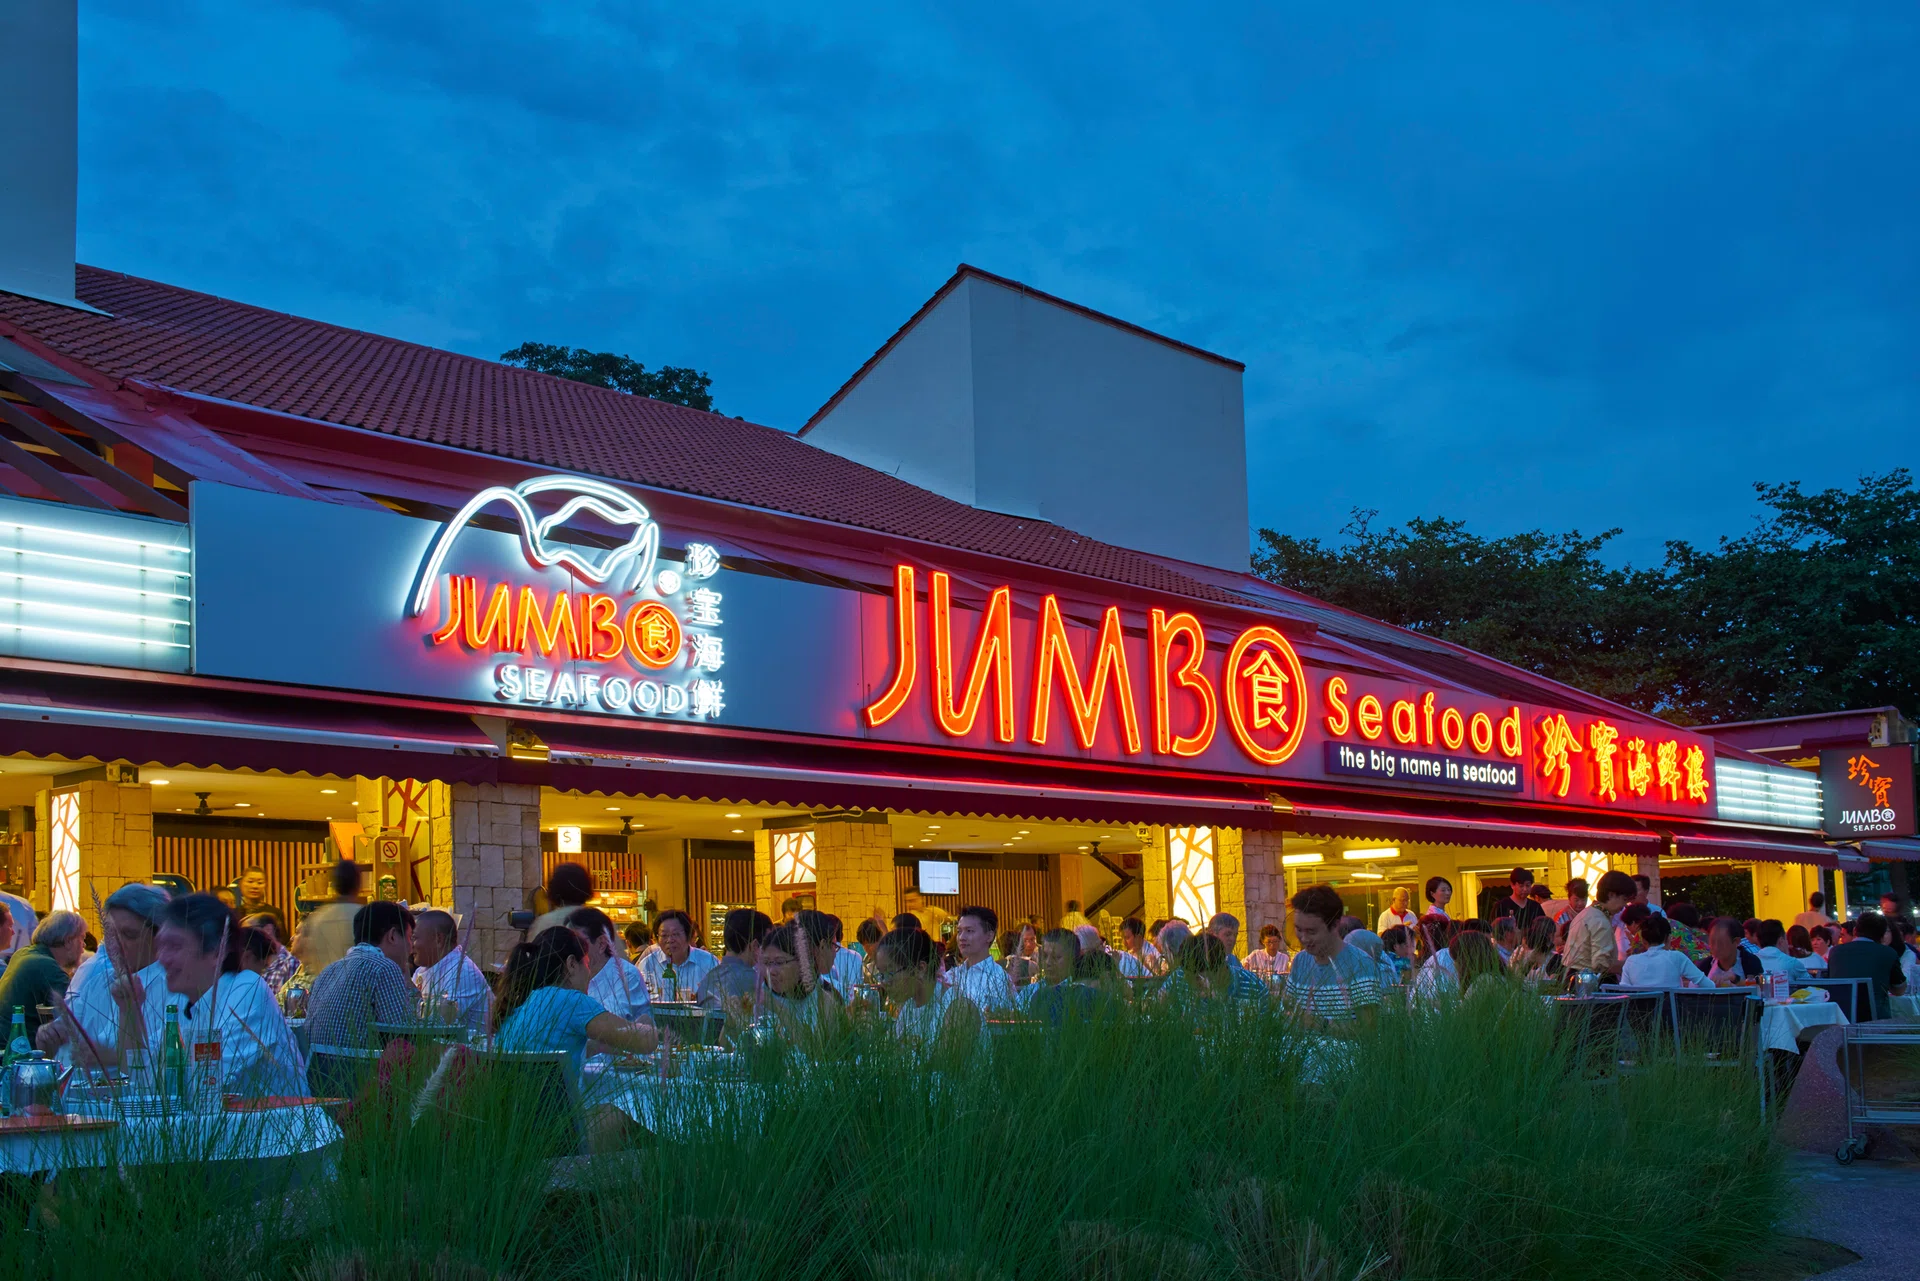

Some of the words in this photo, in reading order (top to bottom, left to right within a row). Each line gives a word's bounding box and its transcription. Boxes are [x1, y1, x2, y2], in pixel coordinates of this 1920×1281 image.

[433, 574, 683, 670] JUMBO
[499, 664, 689, 715] SEAFOOD
[864, 564, 1308, 766] JUMBO
[1324, 677, 1523, 758] Seafood
[1339, 745, 1365, 770] the
[1371, 749, 1395, 777] big
[1400, 757, 1441, 778] name
[1446, 758, 1459, 779] in
[1462, 763, 1517, 786] seafood
[1839, 808, 1896, 824] JUMBO
[1853, 824, 1896, 832] SEAFOOD
